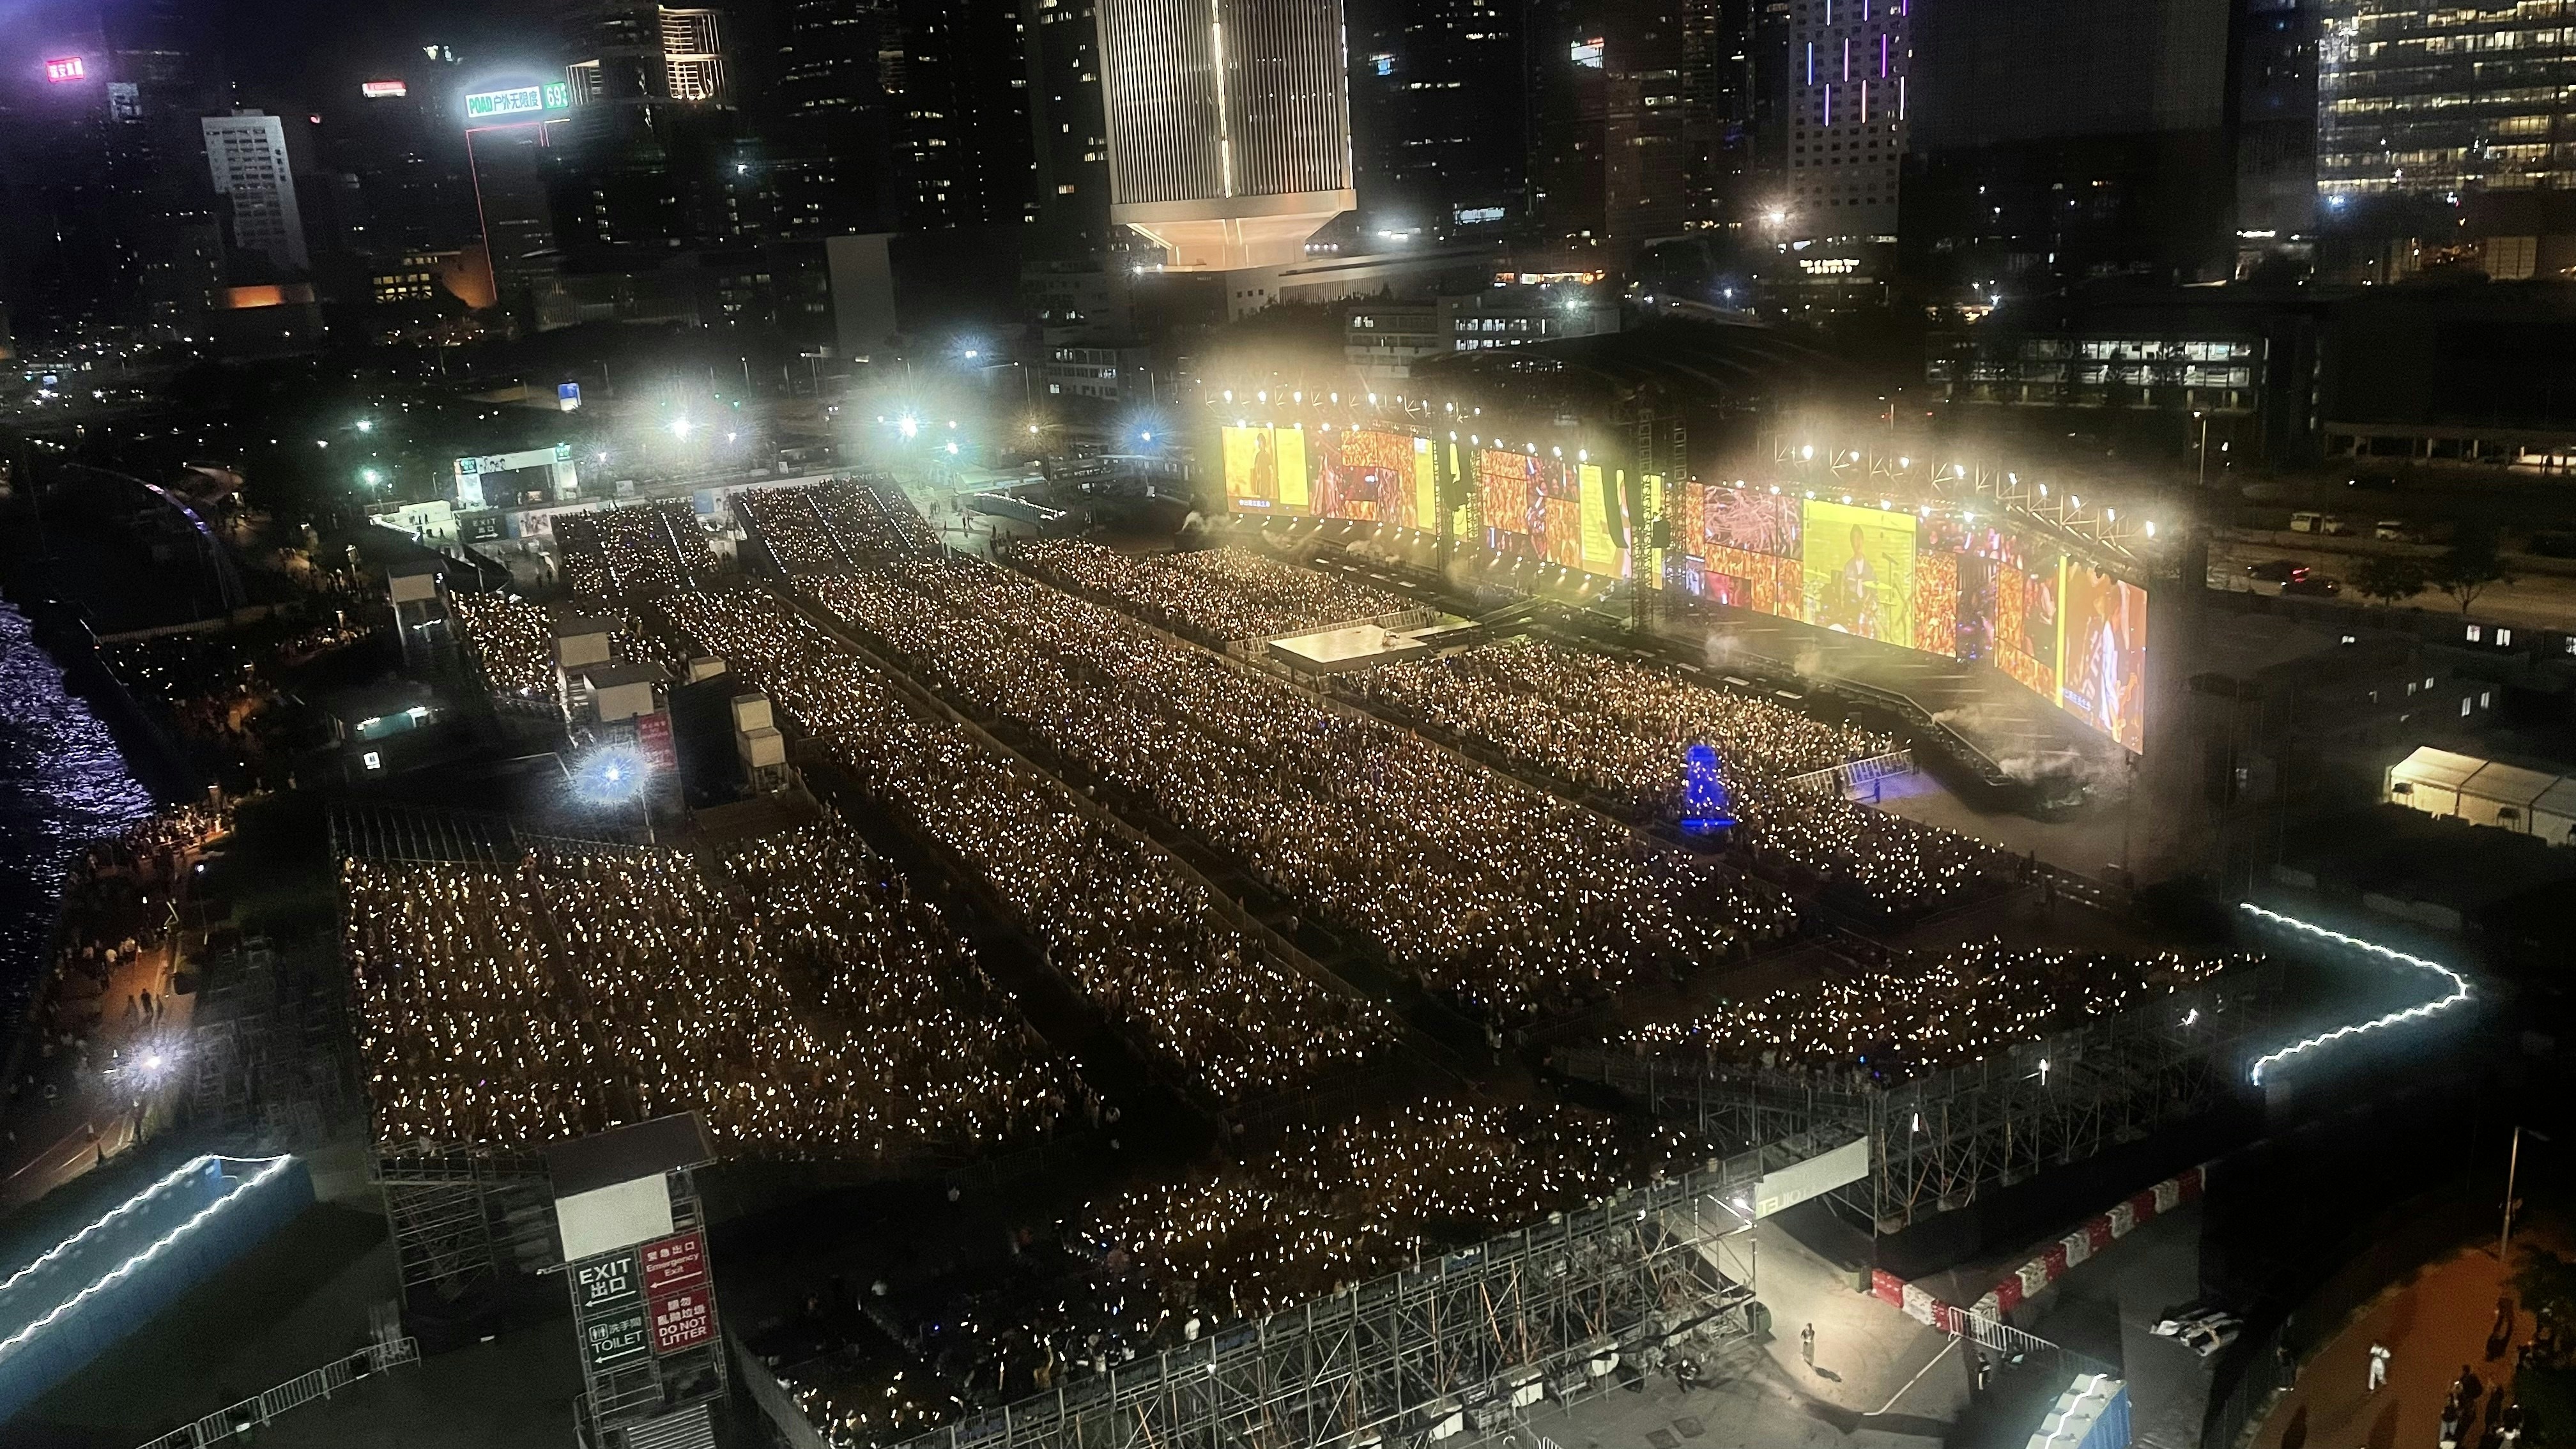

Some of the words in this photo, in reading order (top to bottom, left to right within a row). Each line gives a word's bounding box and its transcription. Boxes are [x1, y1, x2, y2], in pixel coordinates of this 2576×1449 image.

[468, 96, 493, 114] POAD
[473, 518, 496, 527] EXIT
[579, 1257, 631, 1285] EXIT
[646, 1252, 700, 1273] Emergency
[664, 1266, 684, 1277] Exit
[590, 1276, 627, 1300] 出口
[609, 1316, 641, 1335] 洗手間
[659, 1324, 678, 1337] DO
[679, 1315, 707, 1331] NOT
[591, 1330, 643, 1354] TOILET
[662, 1326, 707, 1347] LITTER
